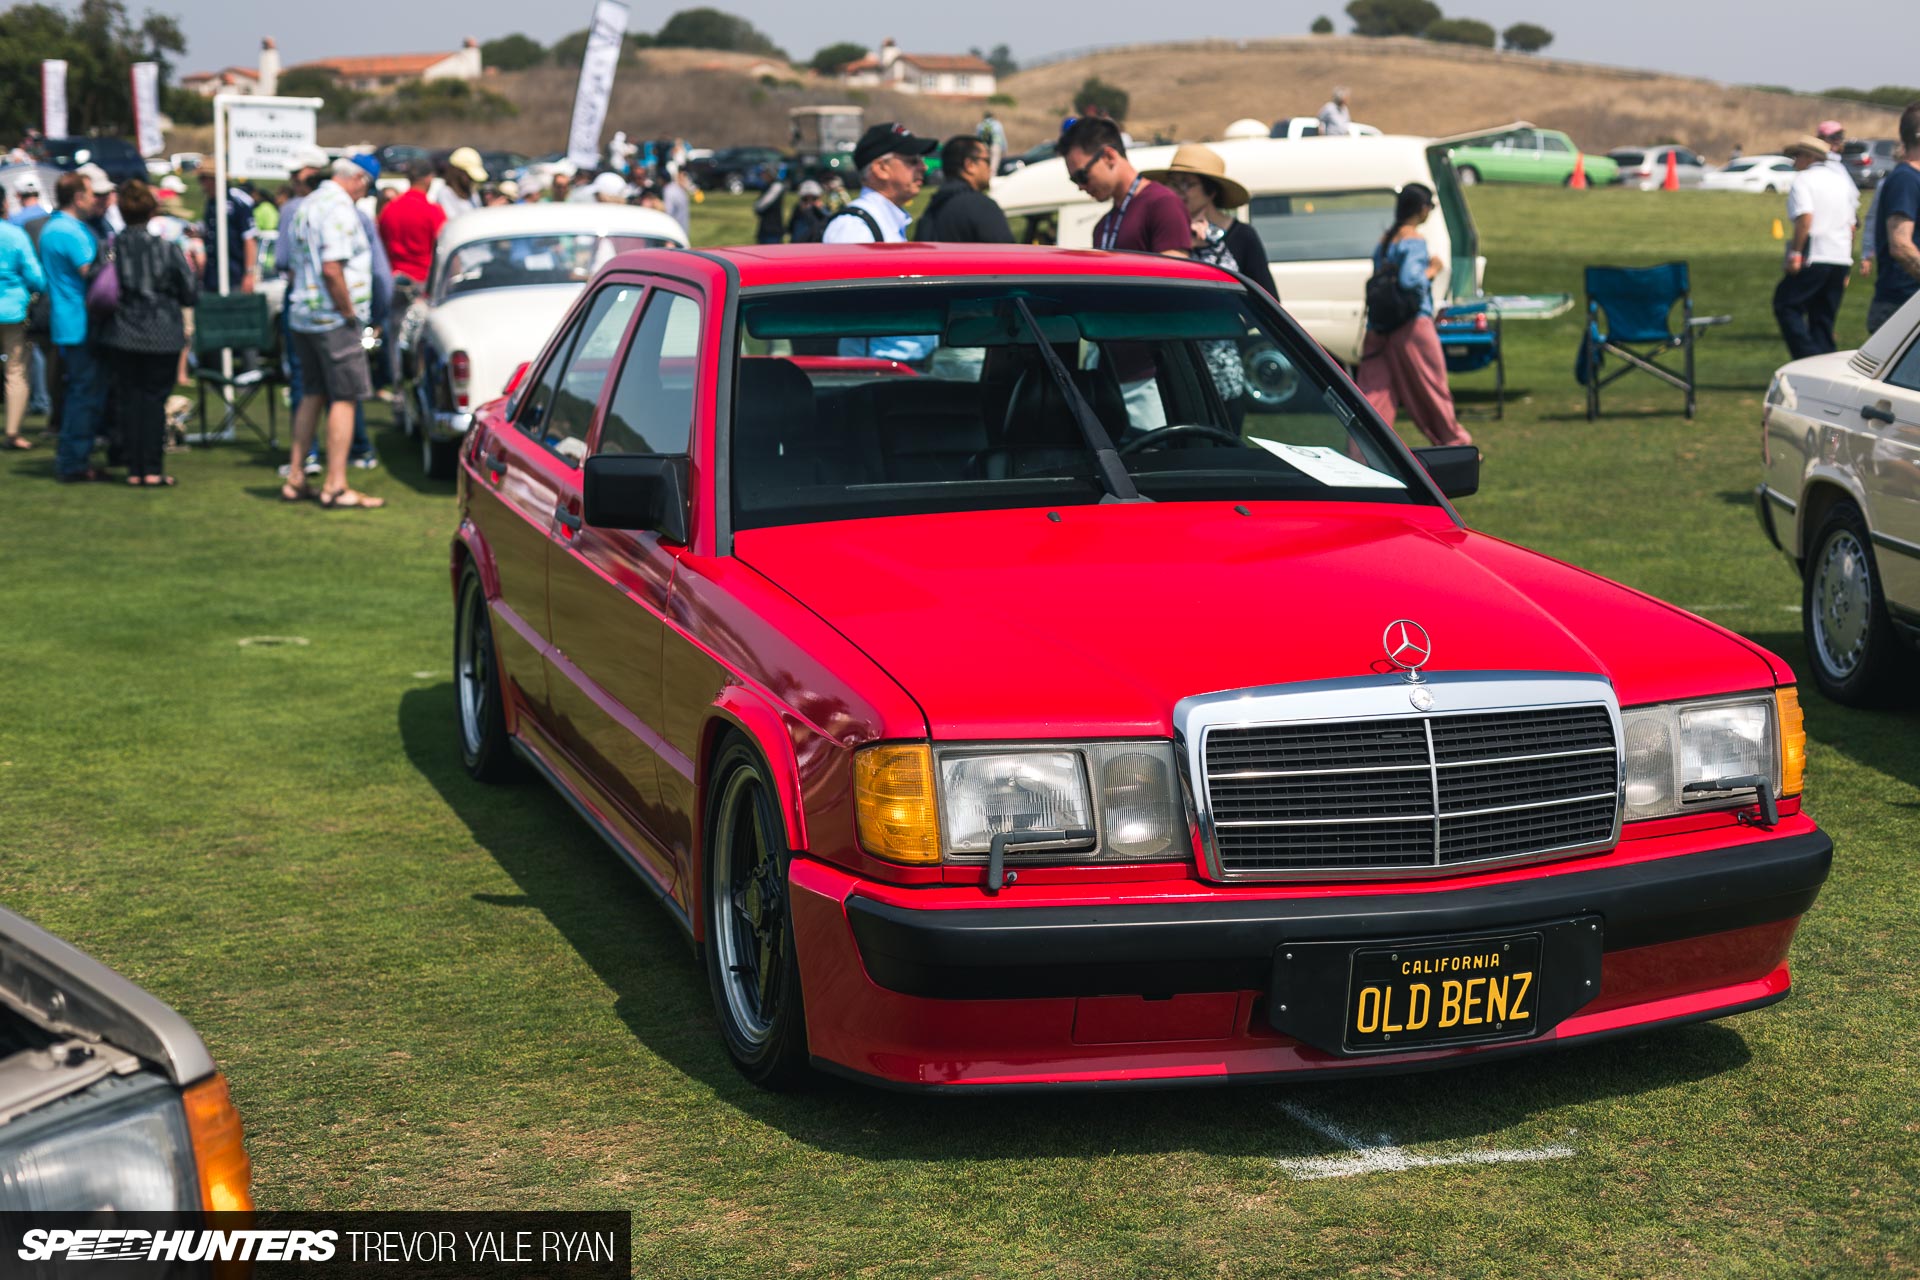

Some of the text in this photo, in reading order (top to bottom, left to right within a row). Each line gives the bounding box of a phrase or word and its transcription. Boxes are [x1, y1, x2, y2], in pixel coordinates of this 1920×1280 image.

[1401, 953, 1500, 975] CALIFORNIA
[1356, 971, 1533, 1033] OLD BENZ
